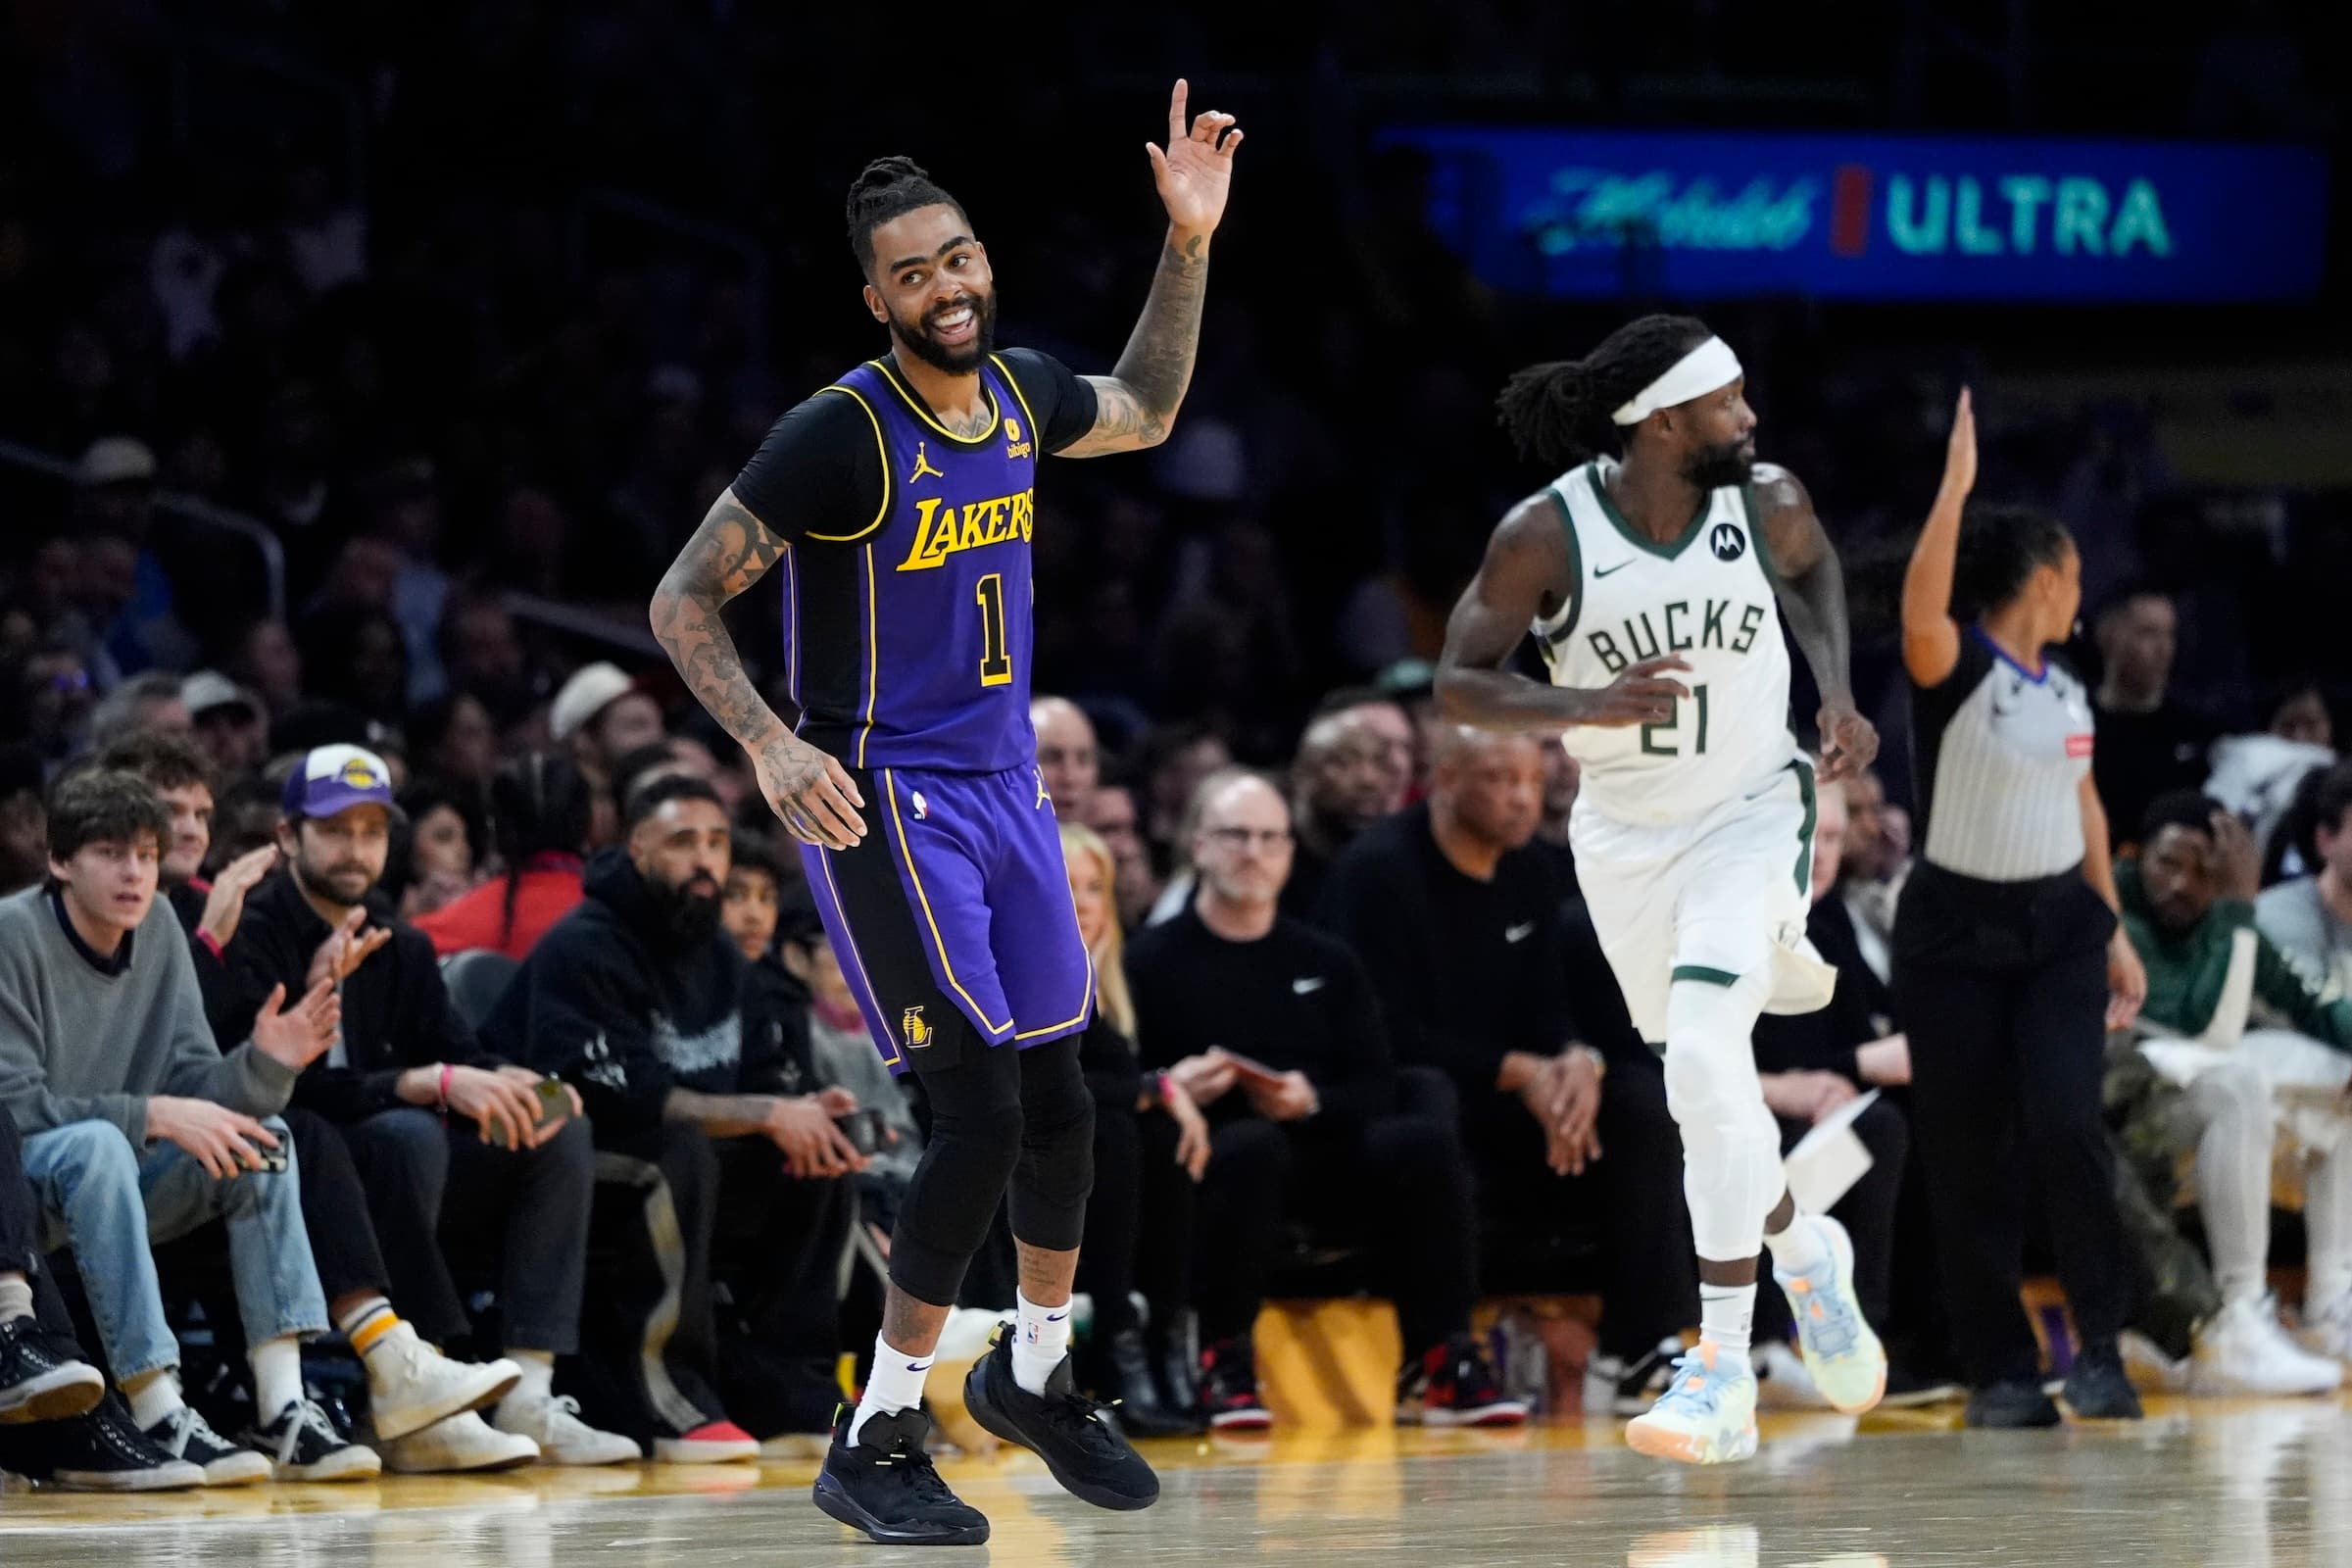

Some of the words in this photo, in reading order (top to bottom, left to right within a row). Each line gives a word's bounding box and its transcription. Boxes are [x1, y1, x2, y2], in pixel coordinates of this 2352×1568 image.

[1886, 174, 2171, 256] ULTRA
[1006, 442, 1031, 459] bibigo
[895, 487, 1035, 571] LAKERS
[976, 572, 1012, 688] 1
[1588, 599, 1765, 674] BUCKS
[1641, 683, 1708, 757] 21
